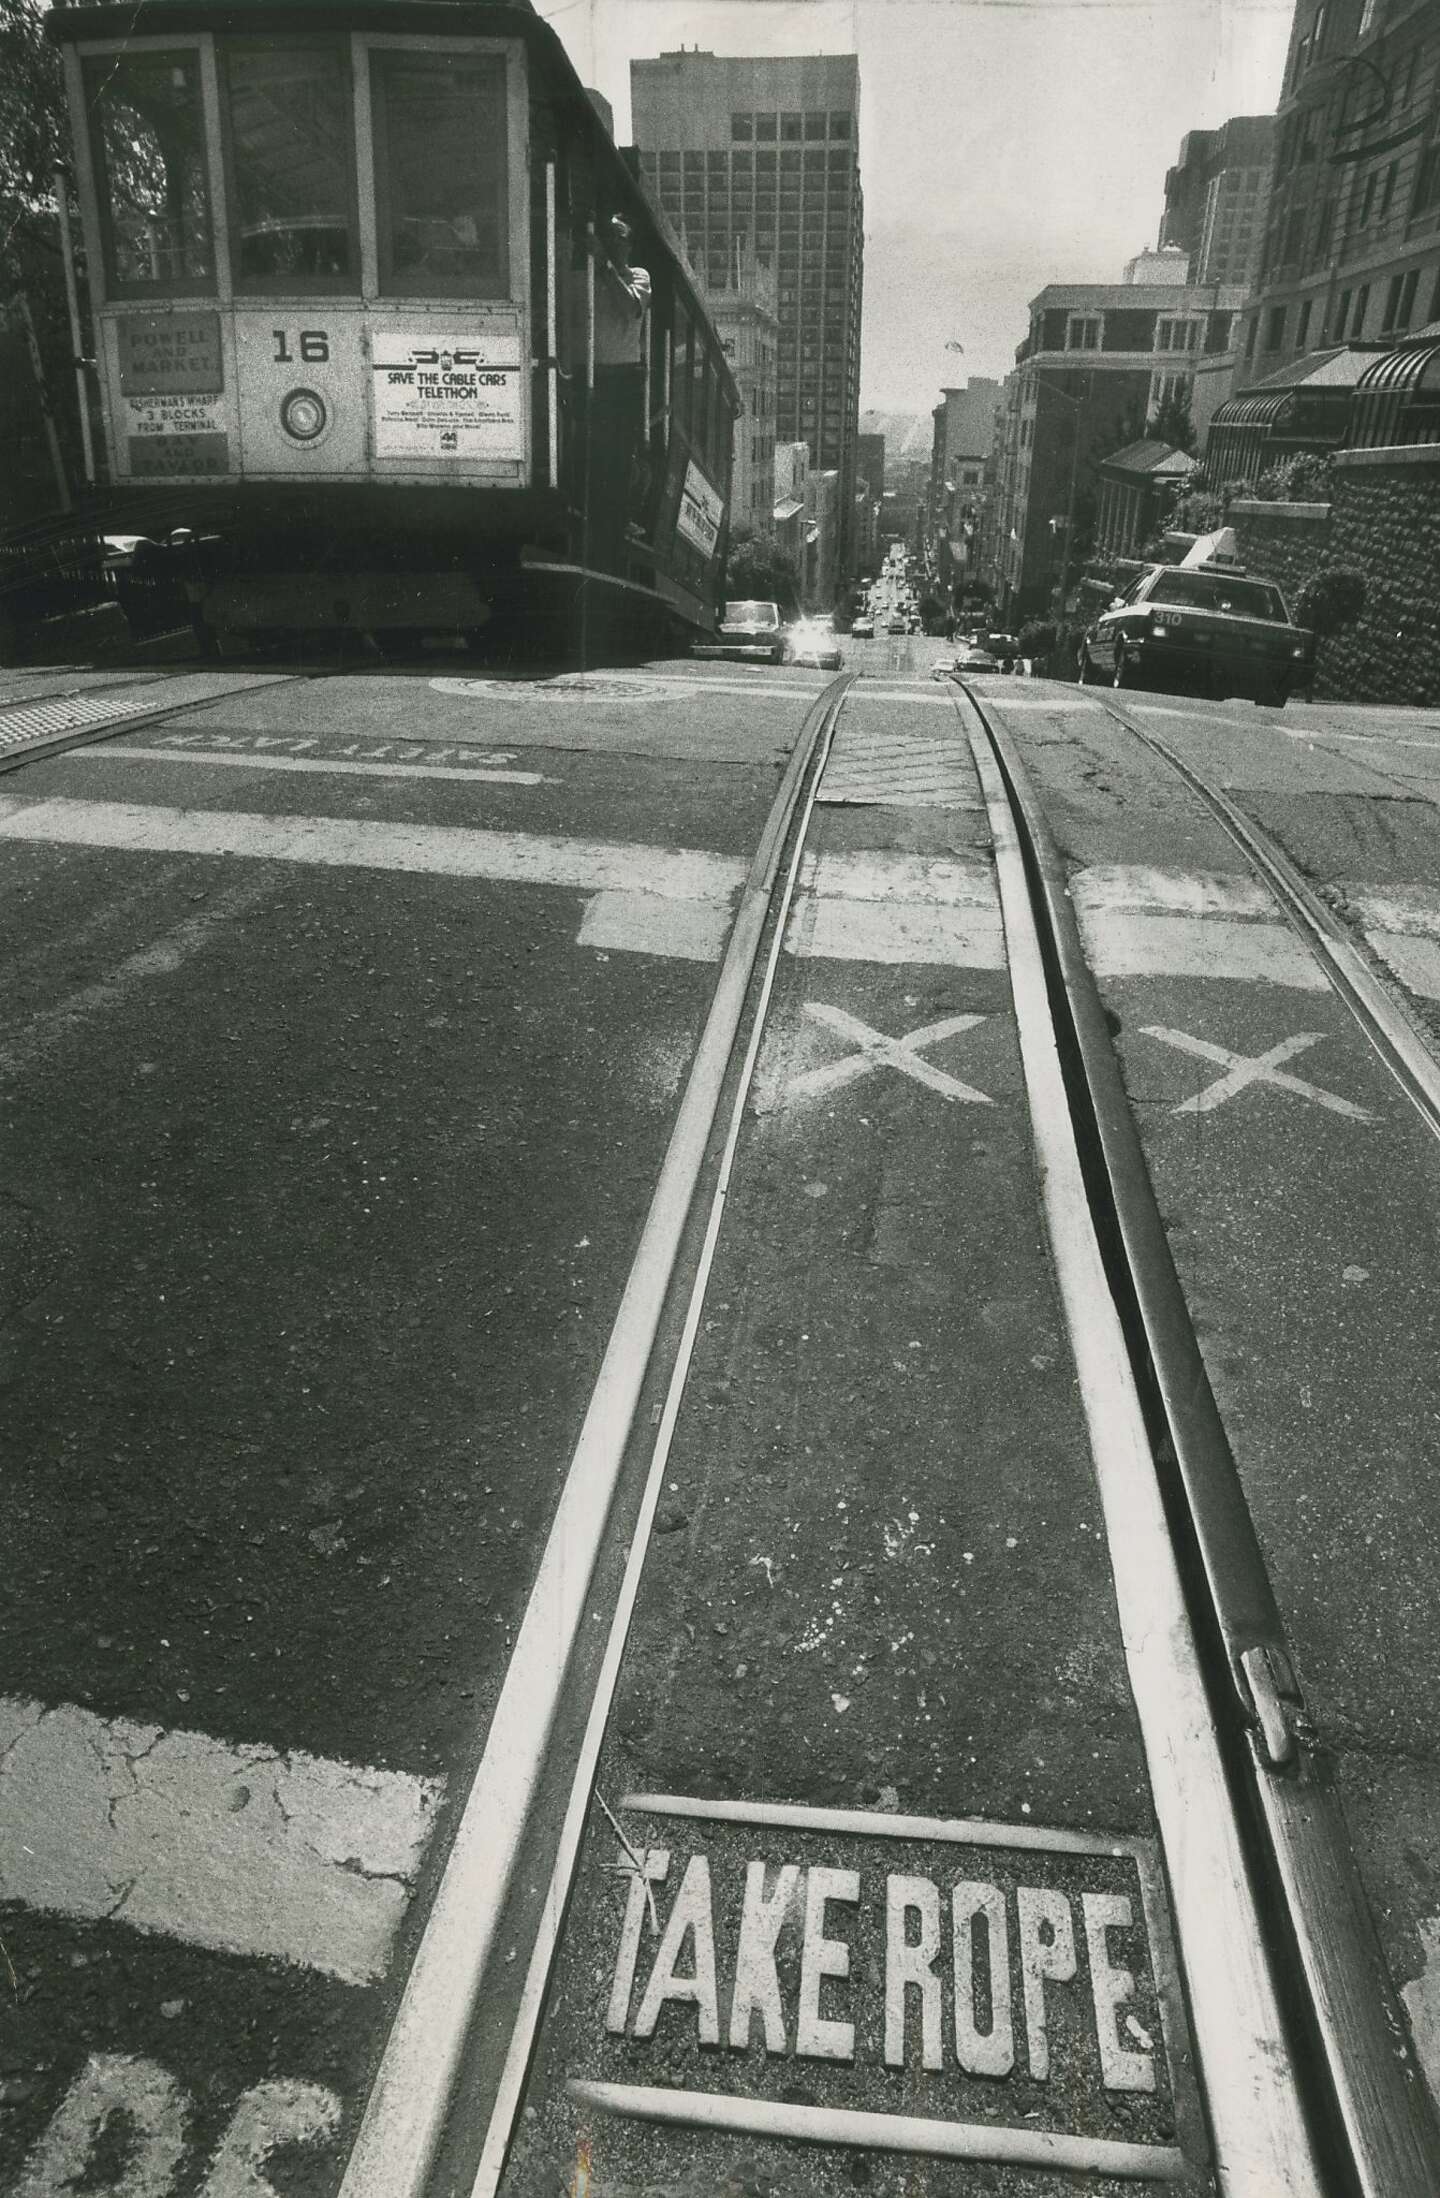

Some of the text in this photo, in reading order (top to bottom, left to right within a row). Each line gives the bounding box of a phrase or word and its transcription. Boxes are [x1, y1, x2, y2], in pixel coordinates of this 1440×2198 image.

[130, 330, 210, 348] POWELL
[152, 347, 187, 358] AND
[272, 330, 330, 363] 16
[132, 356, 211, 373] MARKET
[387, 372, 507, 386] SAVE THE CABLE CARS
[417, 386, 478, 399] TELETHON
[187, 395, 219, 408] WHARF
[147, 408, 207, 421] 3 BLOCKS
[136, 419, 218, 433] FROM TERMINAL
[1154, 611, 1182, 626] 310
[152, 733, 517, 765] SAFETY LATCH
[605, 1847, 1157, 2094] TAKE ROPE
